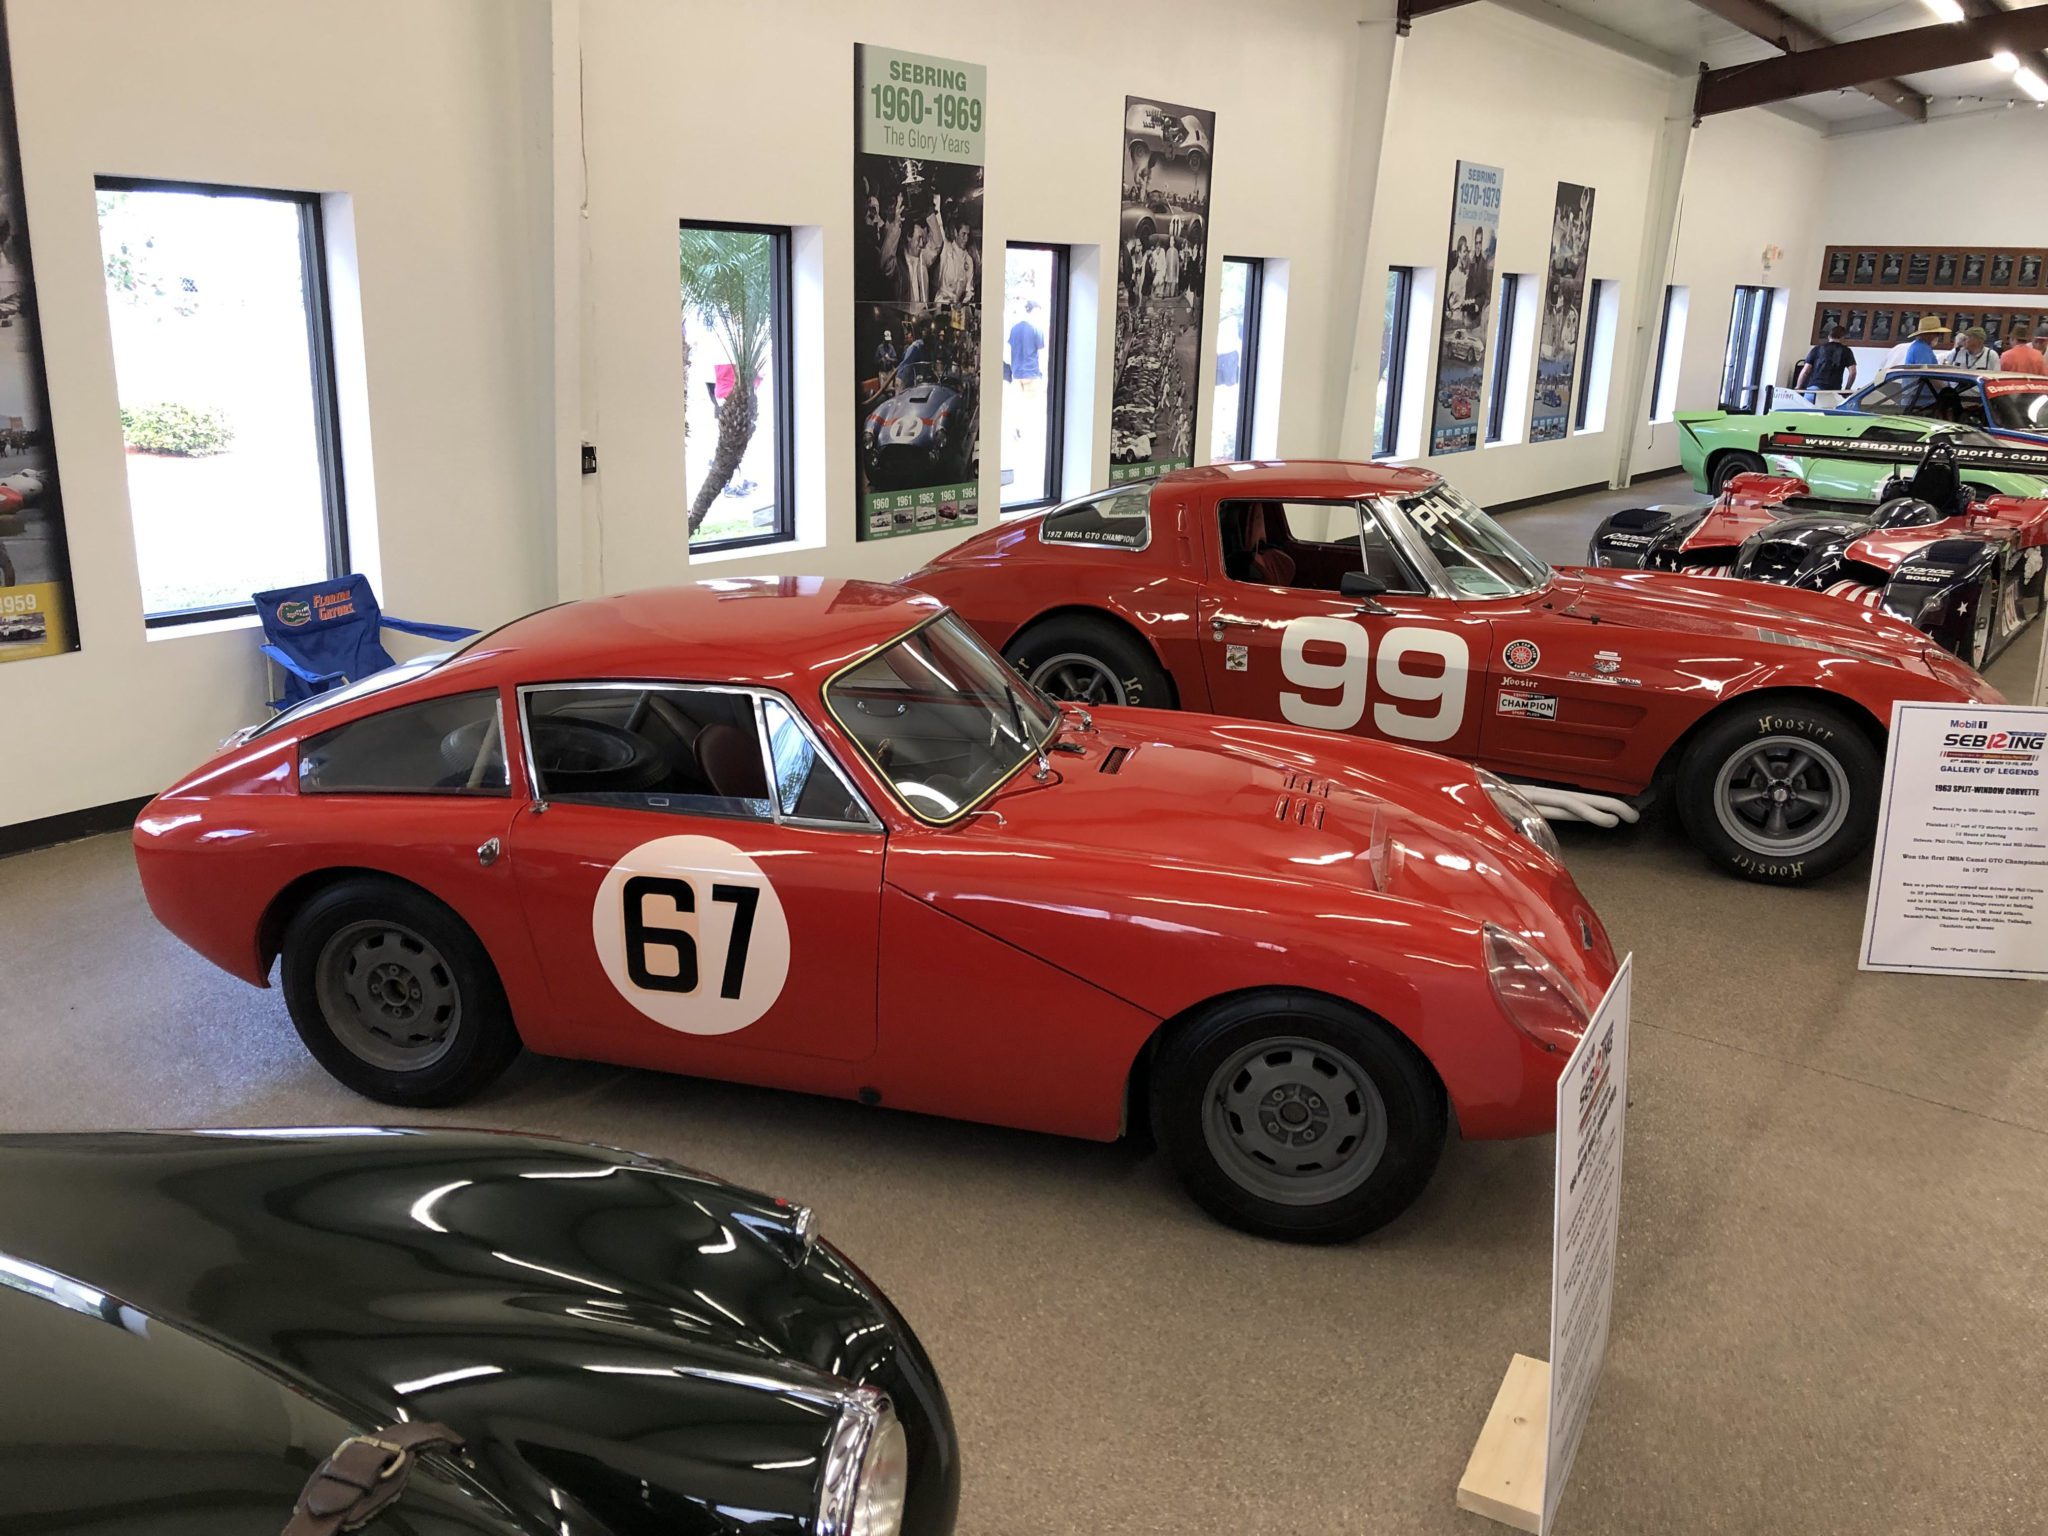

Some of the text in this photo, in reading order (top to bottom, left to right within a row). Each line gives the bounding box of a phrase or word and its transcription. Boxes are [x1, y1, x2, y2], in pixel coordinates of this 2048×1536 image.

[889, 60, 967, 92] SEBRING
[871, 83, 982, 133] 1960-1969
[884, 125, 970, 154] The Glory Years
[1468, 168, 1497, 185] SEBRING
[1460, 182, 1501, 209] 1970-1979
[896, 420, 918, 437] 12
[1805, 437, 2047, 462] www.panozmotports.com
[872, 487, 976, 510] 1960 1961 1962 1963 1964
[1064, 531, 1082, 539] IMSA
[1085, 532, 1100, 540] GTO
[1102, 534, 1136, 544] CHAMPION
[1610, 540, 1639, 549] BOSCH
[1905, 575, 1941, 583] BOSCH
[1279, 616, 1469, 742] 99
[1501, 698, 1553, 712] CHAMPION
[1758, 715, 1835, 741] Hoosier
[1950, 719, 1977, 729] Mobil
[1940, 765, 1981, 774] GALLERY
[1999, 768, 2039, 776] LEGENDS
[1935, 784, 2040, 796] 1963 SPLIT-WINDOW CORVETTE
[1732, 854, 1805, 879] Hoosier
[622, 875, 760, 1000] 67
